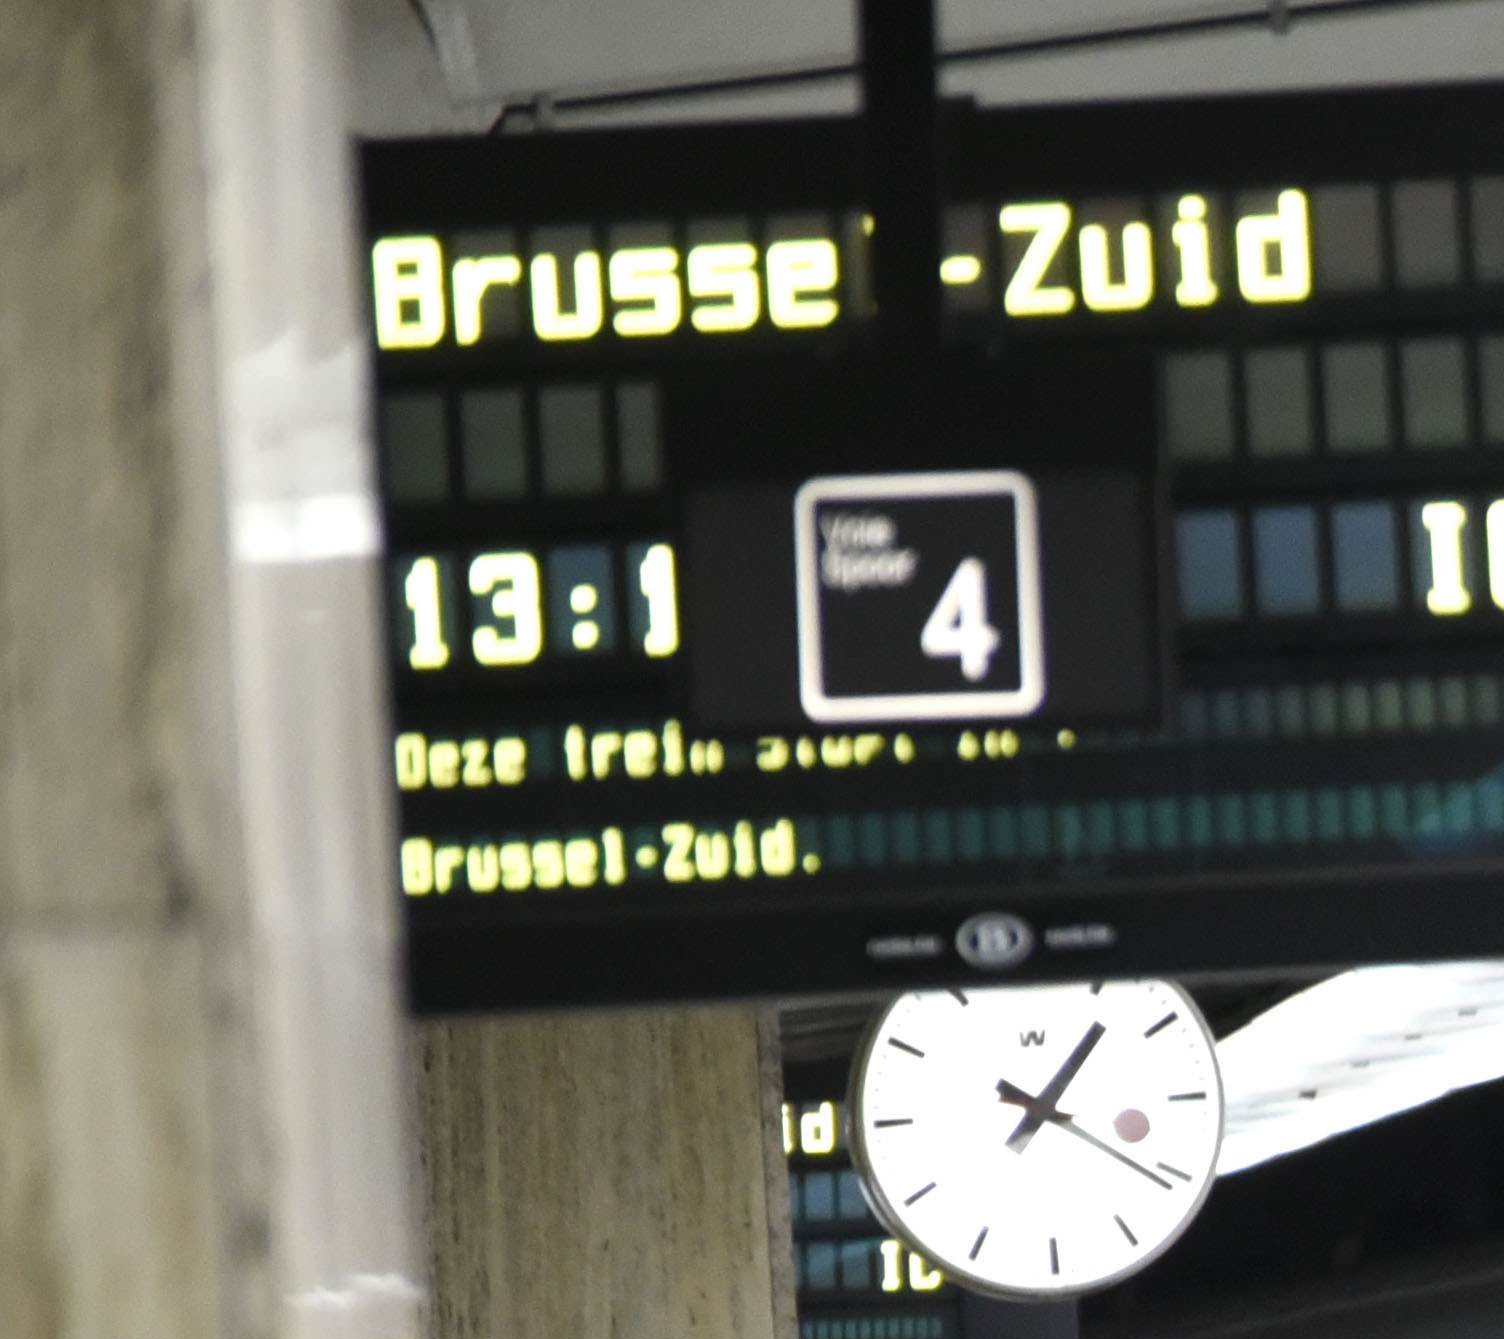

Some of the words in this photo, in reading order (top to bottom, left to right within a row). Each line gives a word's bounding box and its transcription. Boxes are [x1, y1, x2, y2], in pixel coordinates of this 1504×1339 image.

[371, 189, 1312, 349] Brusse-Zuid
[920, 556, 999, 681] 4
[394, 731, 527, 789] Deze
